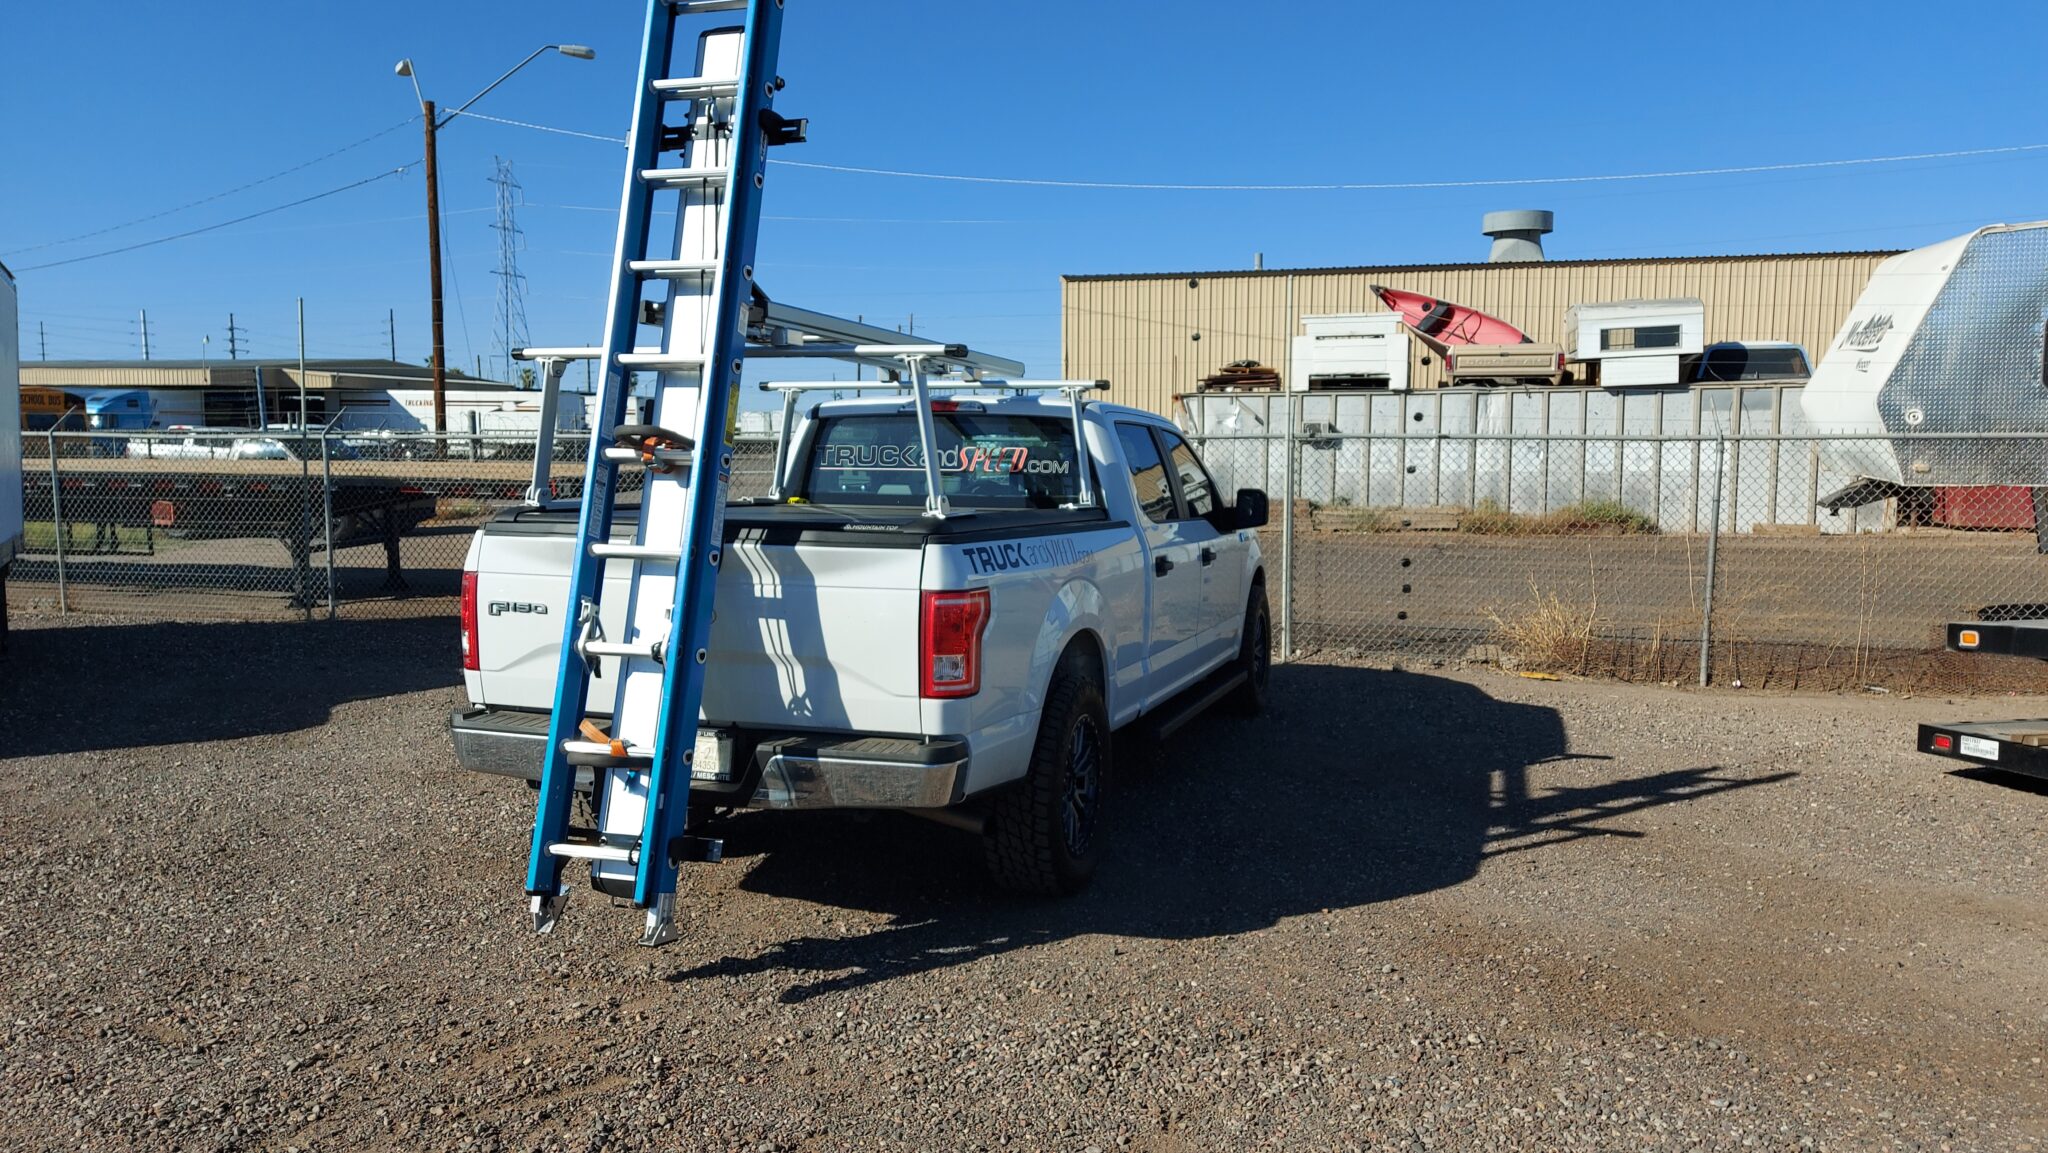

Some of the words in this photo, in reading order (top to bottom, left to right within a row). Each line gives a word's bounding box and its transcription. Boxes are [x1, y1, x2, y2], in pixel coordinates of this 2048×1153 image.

[20, 394, 45, 405] SCHOOL
[48, 395, 61, 405] BUS
[405, 399, 434, 407] TRUCKING
[852, 523, 885, 531] MOUNTAIN
